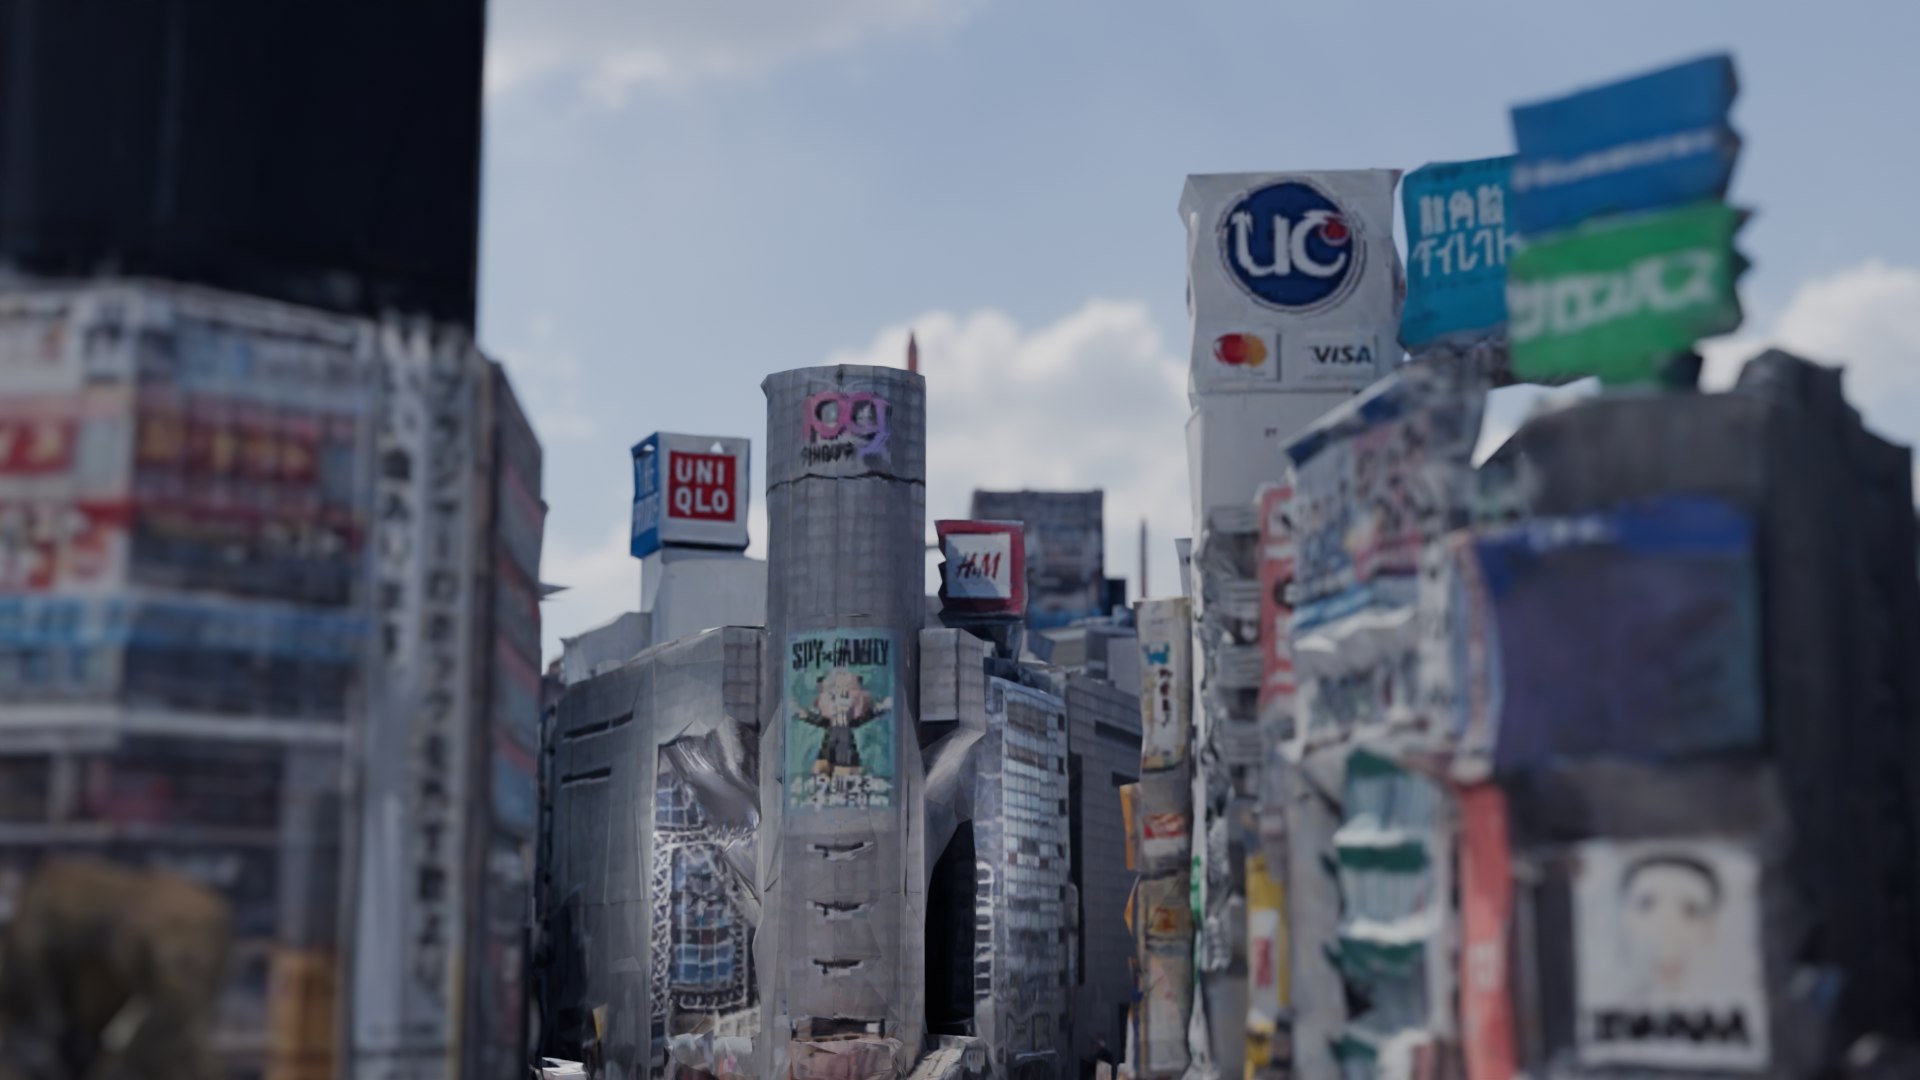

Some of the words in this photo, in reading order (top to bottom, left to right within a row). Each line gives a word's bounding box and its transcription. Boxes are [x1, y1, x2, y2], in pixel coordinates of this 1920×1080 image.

[1313, 345, 1371, 363] VISA
[675, 456, 725, 486] UNI
[674, 485, 730, 516] QLO
